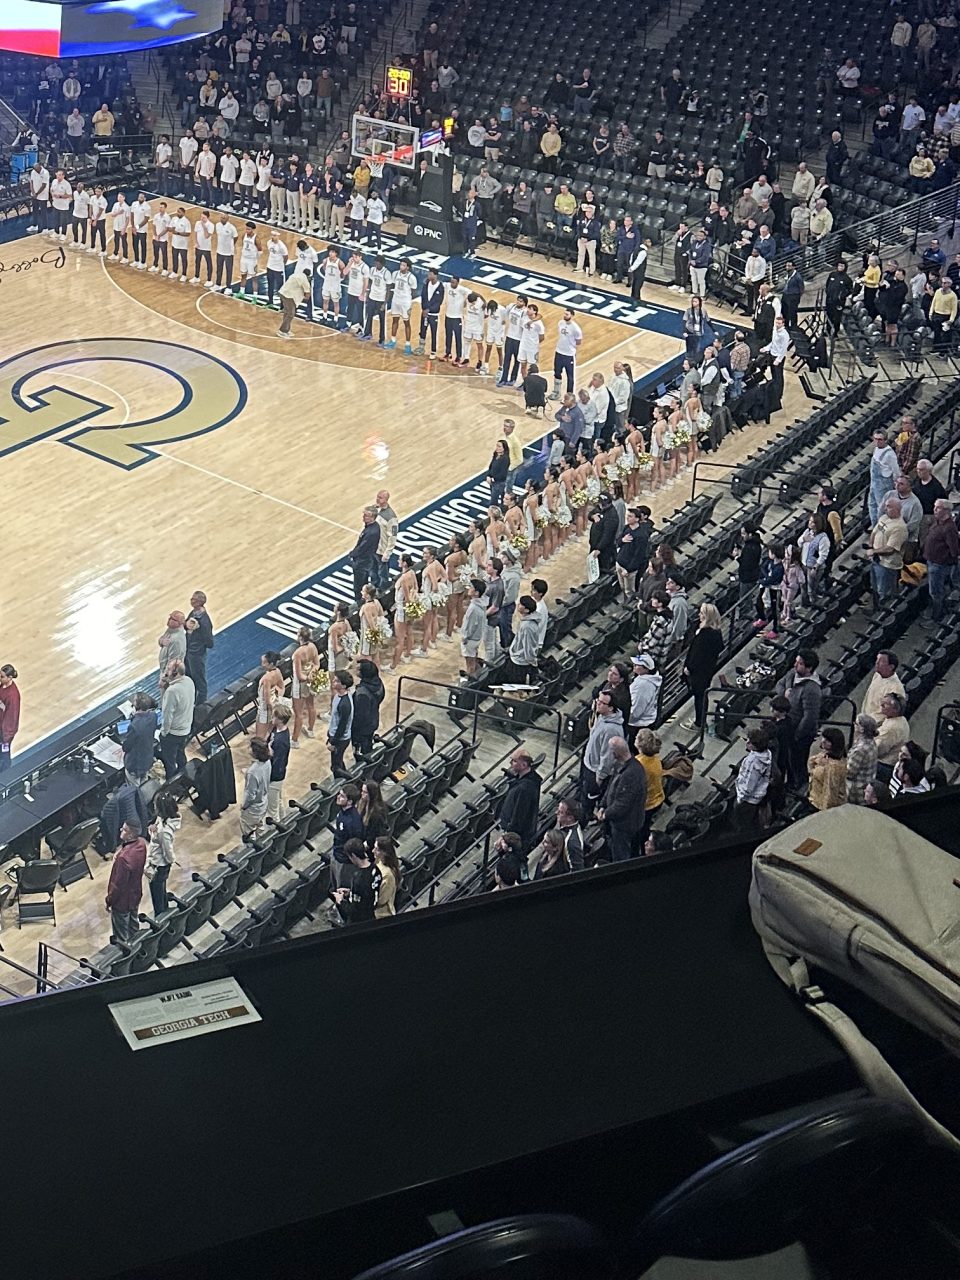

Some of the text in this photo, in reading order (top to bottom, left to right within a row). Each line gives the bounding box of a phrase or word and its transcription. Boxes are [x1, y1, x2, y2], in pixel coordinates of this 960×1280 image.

[389, 79, 408, 95] 30
[423, 228, 442, 240] PNC
[472, 265, 659, 324] TECH
[151, 1010, 231, 1036] GEORGIA TECH
